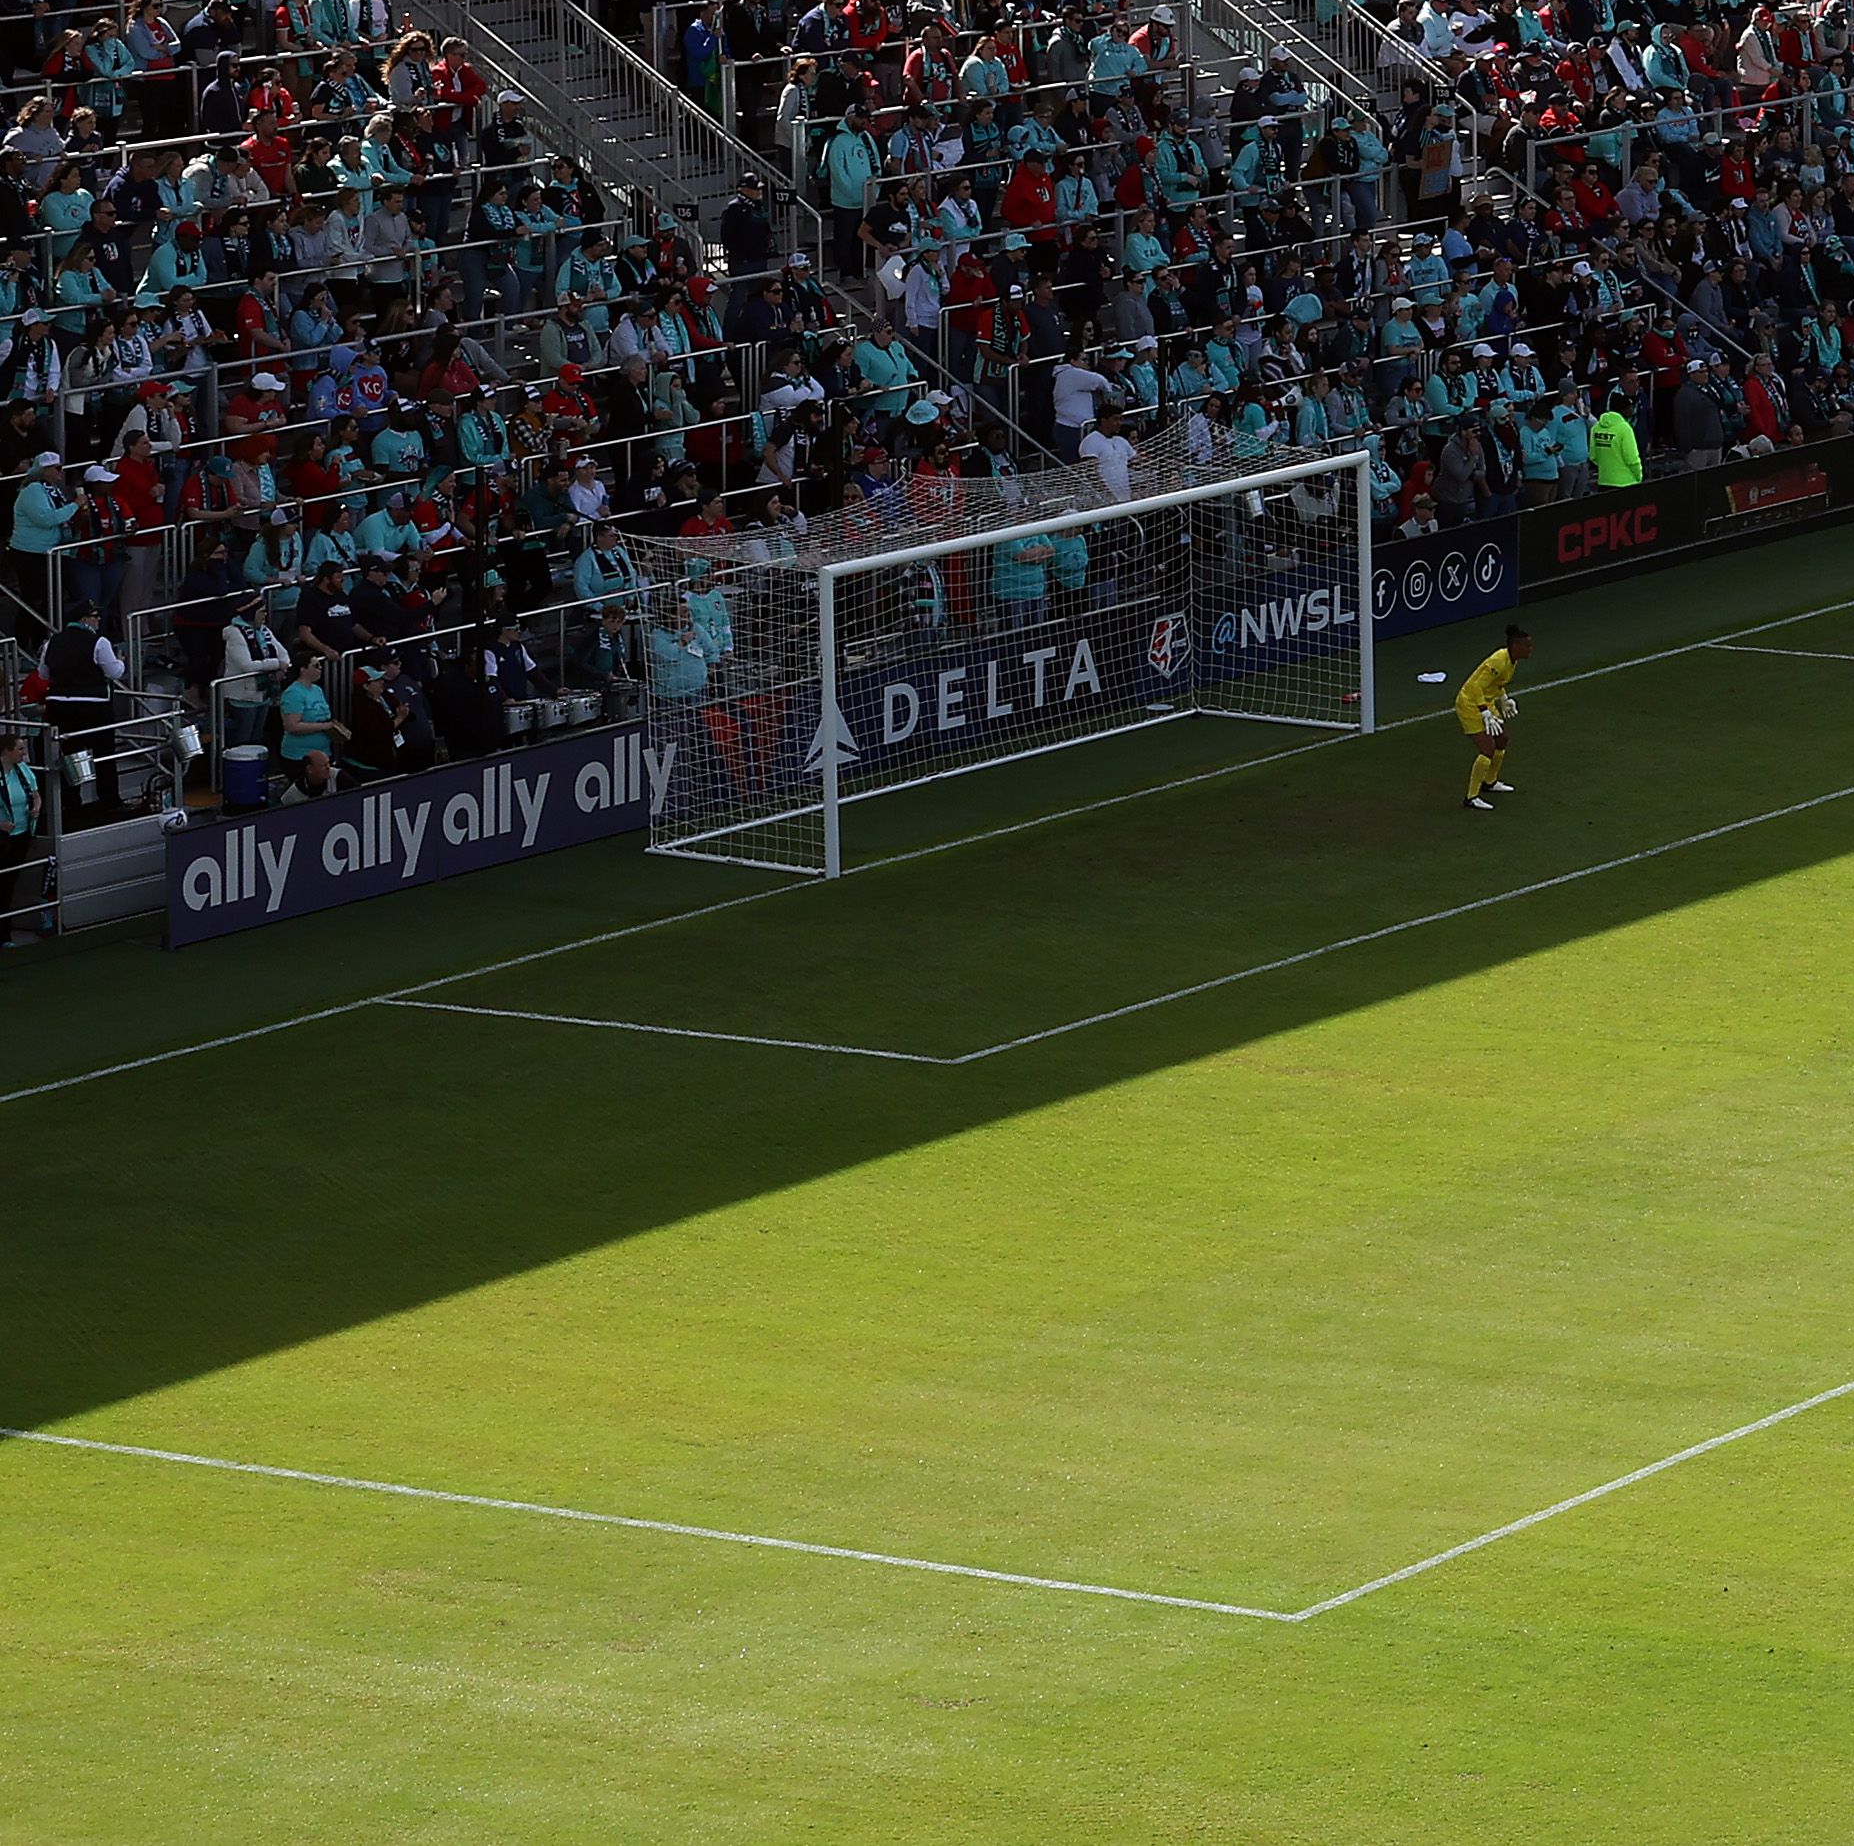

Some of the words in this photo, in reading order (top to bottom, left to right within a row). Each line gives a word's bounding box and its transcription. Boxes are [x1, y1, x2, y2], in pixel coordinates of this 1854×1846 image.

[677, 207, 692, 218] 136
[775, 191, 790, 202] 137
[364, 381, 381, 396] KC
[1594, 432, 1616, 441] BEST
[1557, 504, 1659, 563] CPKC
[1212, 585, 1356, 654] @NWSL
[883, 637, 1102, 745] DELTA
[182, 824, 297, 912] ally
[322, 791, 431, 879] ally
[441, 763, 551, 849] ally
[573, 732, 677, 815] ally
